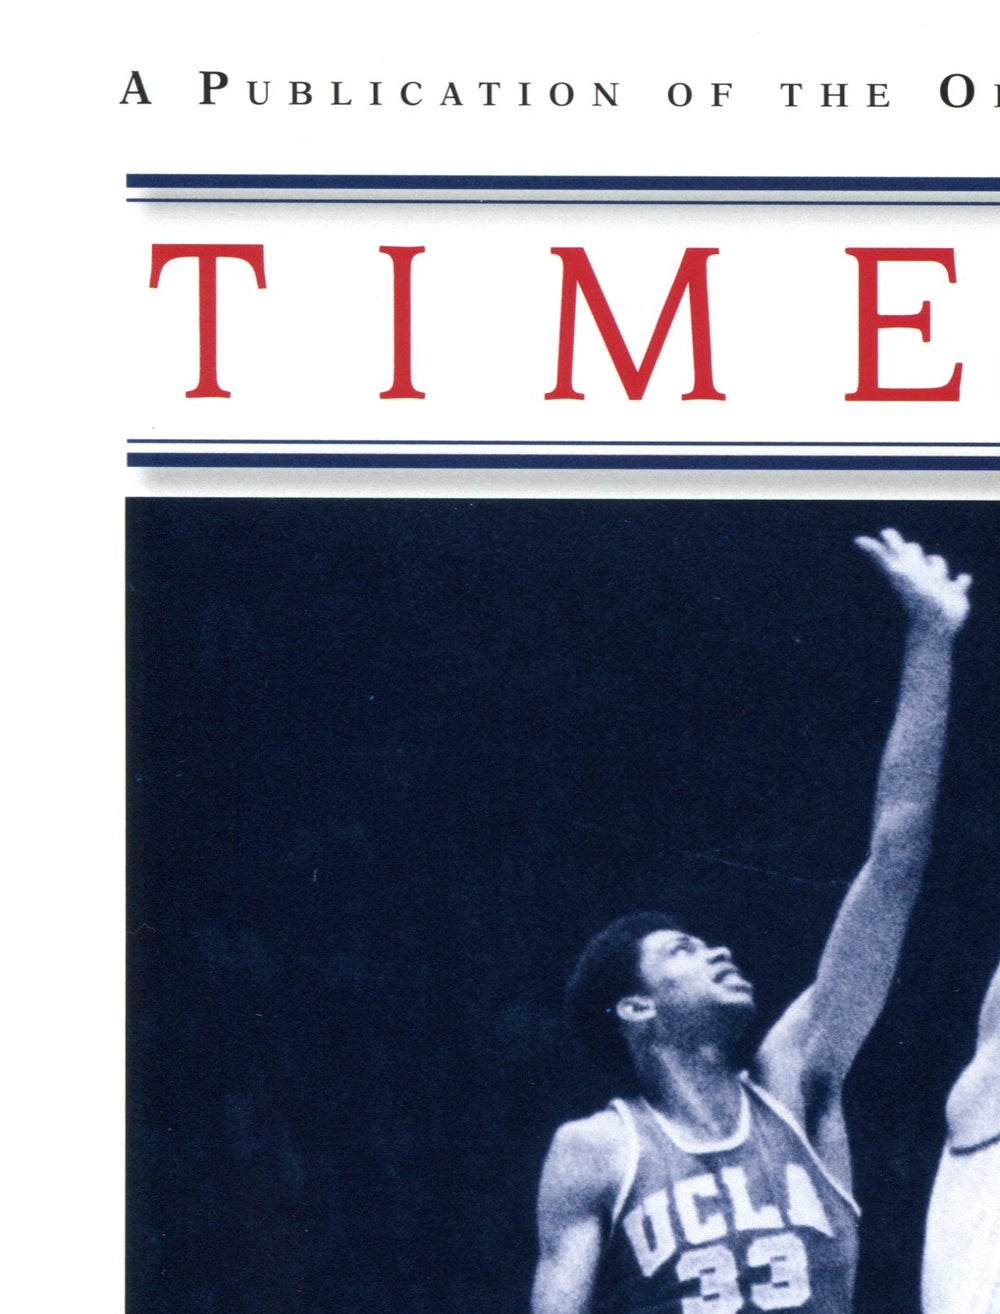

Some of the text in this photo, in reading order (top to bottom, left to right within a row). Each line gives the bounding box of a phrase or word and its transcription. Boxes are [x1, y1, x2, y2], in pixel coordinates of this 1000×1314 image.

[118, 70, 153, 105] A
[197, 69, 620, 107] PUBLICATION
[666, 82, 734, 107] OF
[779, 83, 891, 108] THE
[622, 1163, 836, 1278] UCLA
